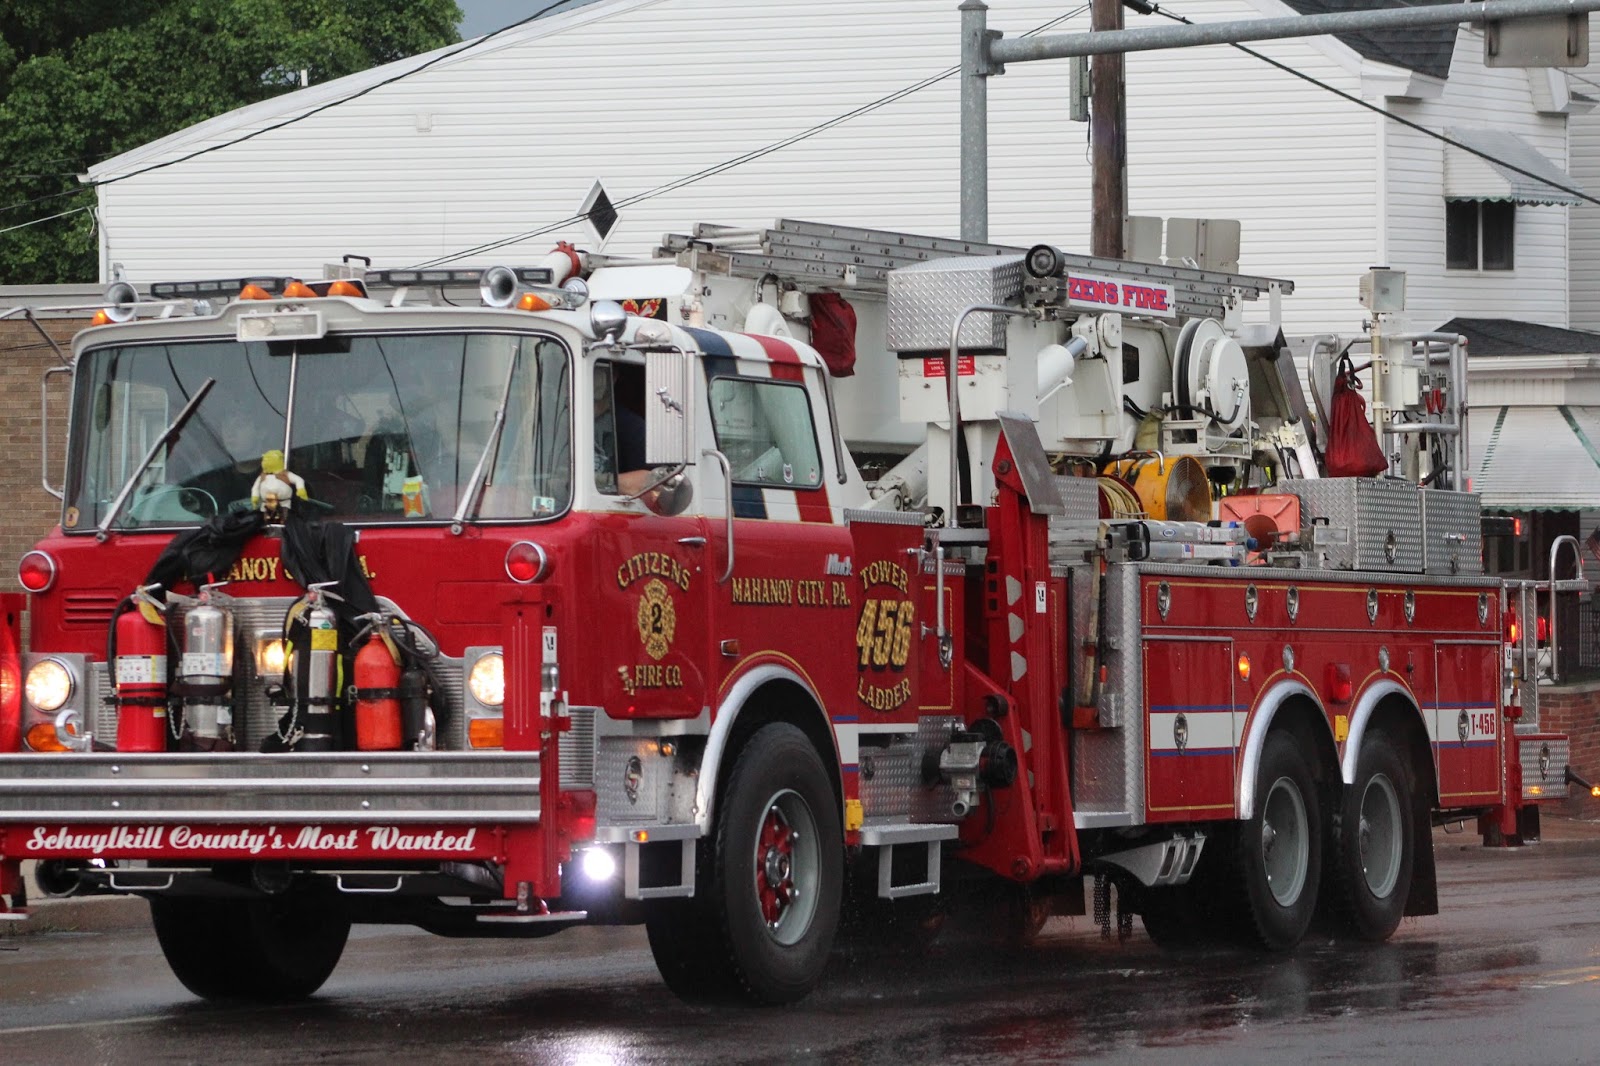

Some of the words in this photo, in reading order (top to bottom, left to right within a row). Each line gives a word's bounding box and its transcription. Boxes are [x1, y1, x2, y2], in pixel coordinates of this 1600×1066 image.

[1068, 276, 1119, 305] ZENS
[1121, 283, 1168, 311] FIRE
[224, 557, 280, 581] ANOY
[617, 552, 690, 592] CITIZENS
[859, 560, 909, 594] TOWER
[731, 577, 794, 604] MAHANOY
[832, 580, 852, 606] PA.
[651, 602, 663, 634] 2
[856, 599, 915, 669] 456
[634, 665, 663, 688] FIRE
[665, 665, 684, 687] CO.
[857, 676, 911, 711] LADDER
[1470, 713, 1495, 735] T-456
[25, 825, 165, 854] Schuylkill
[168, 825, 286, 855] County's
[287, 825, 359, 851] Most
[365, 826, 477, 852] Wanted
